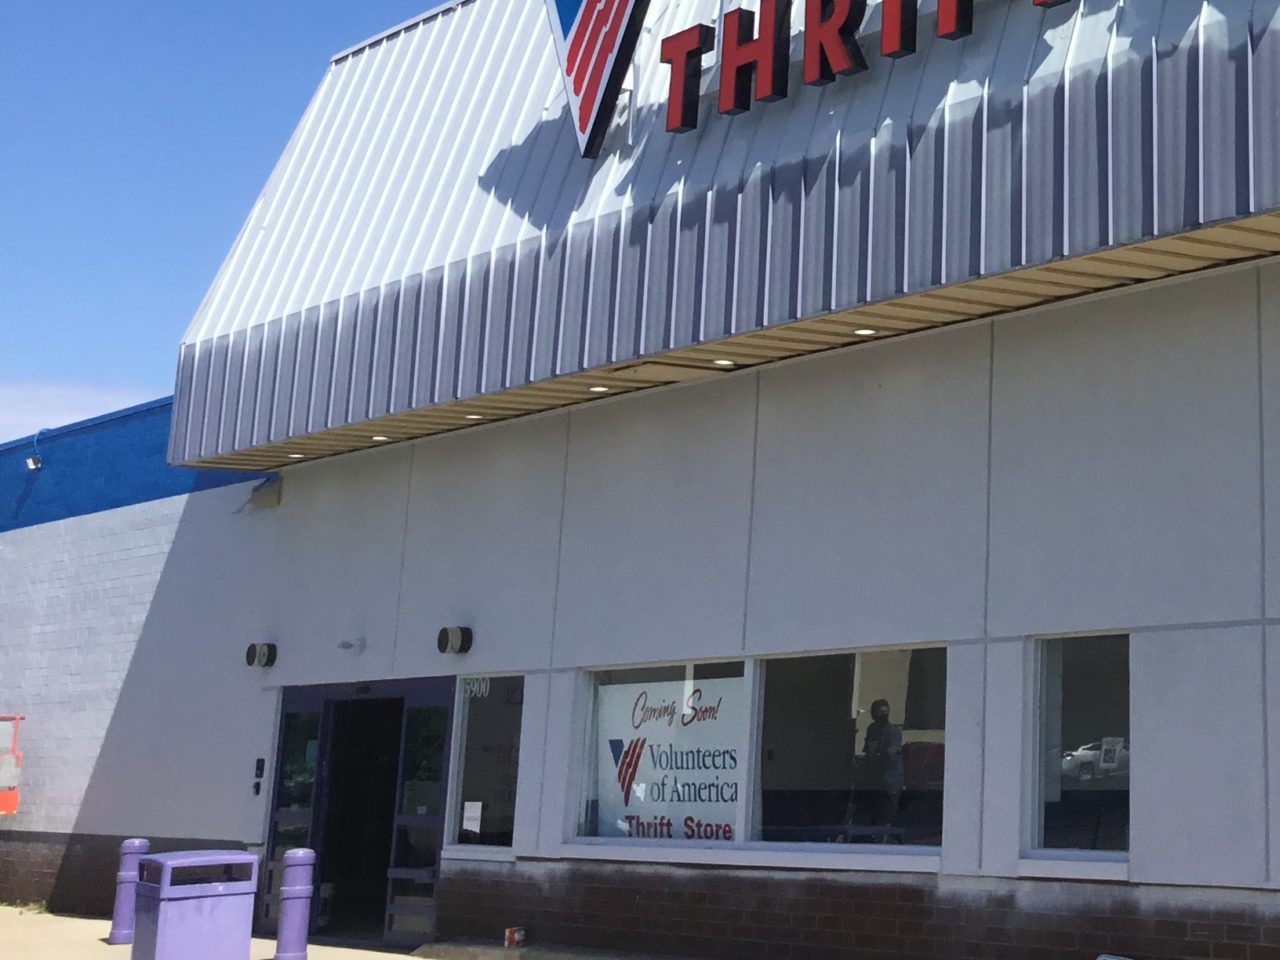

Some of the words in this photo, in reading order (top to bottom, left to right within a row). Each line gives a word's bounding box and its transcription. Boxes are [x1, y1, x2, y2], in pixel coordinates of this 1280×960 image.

[632, 691, 676, 730] Coming
[682, 688, 722, 726] Soon!
[648, 743, 737, 771] Volunteers
[651, 775, 668, 803] of
[669, 776, 738, 803] America
[625, 815, 672, 839] Thrift
[684, 816, 732, 840] Store
